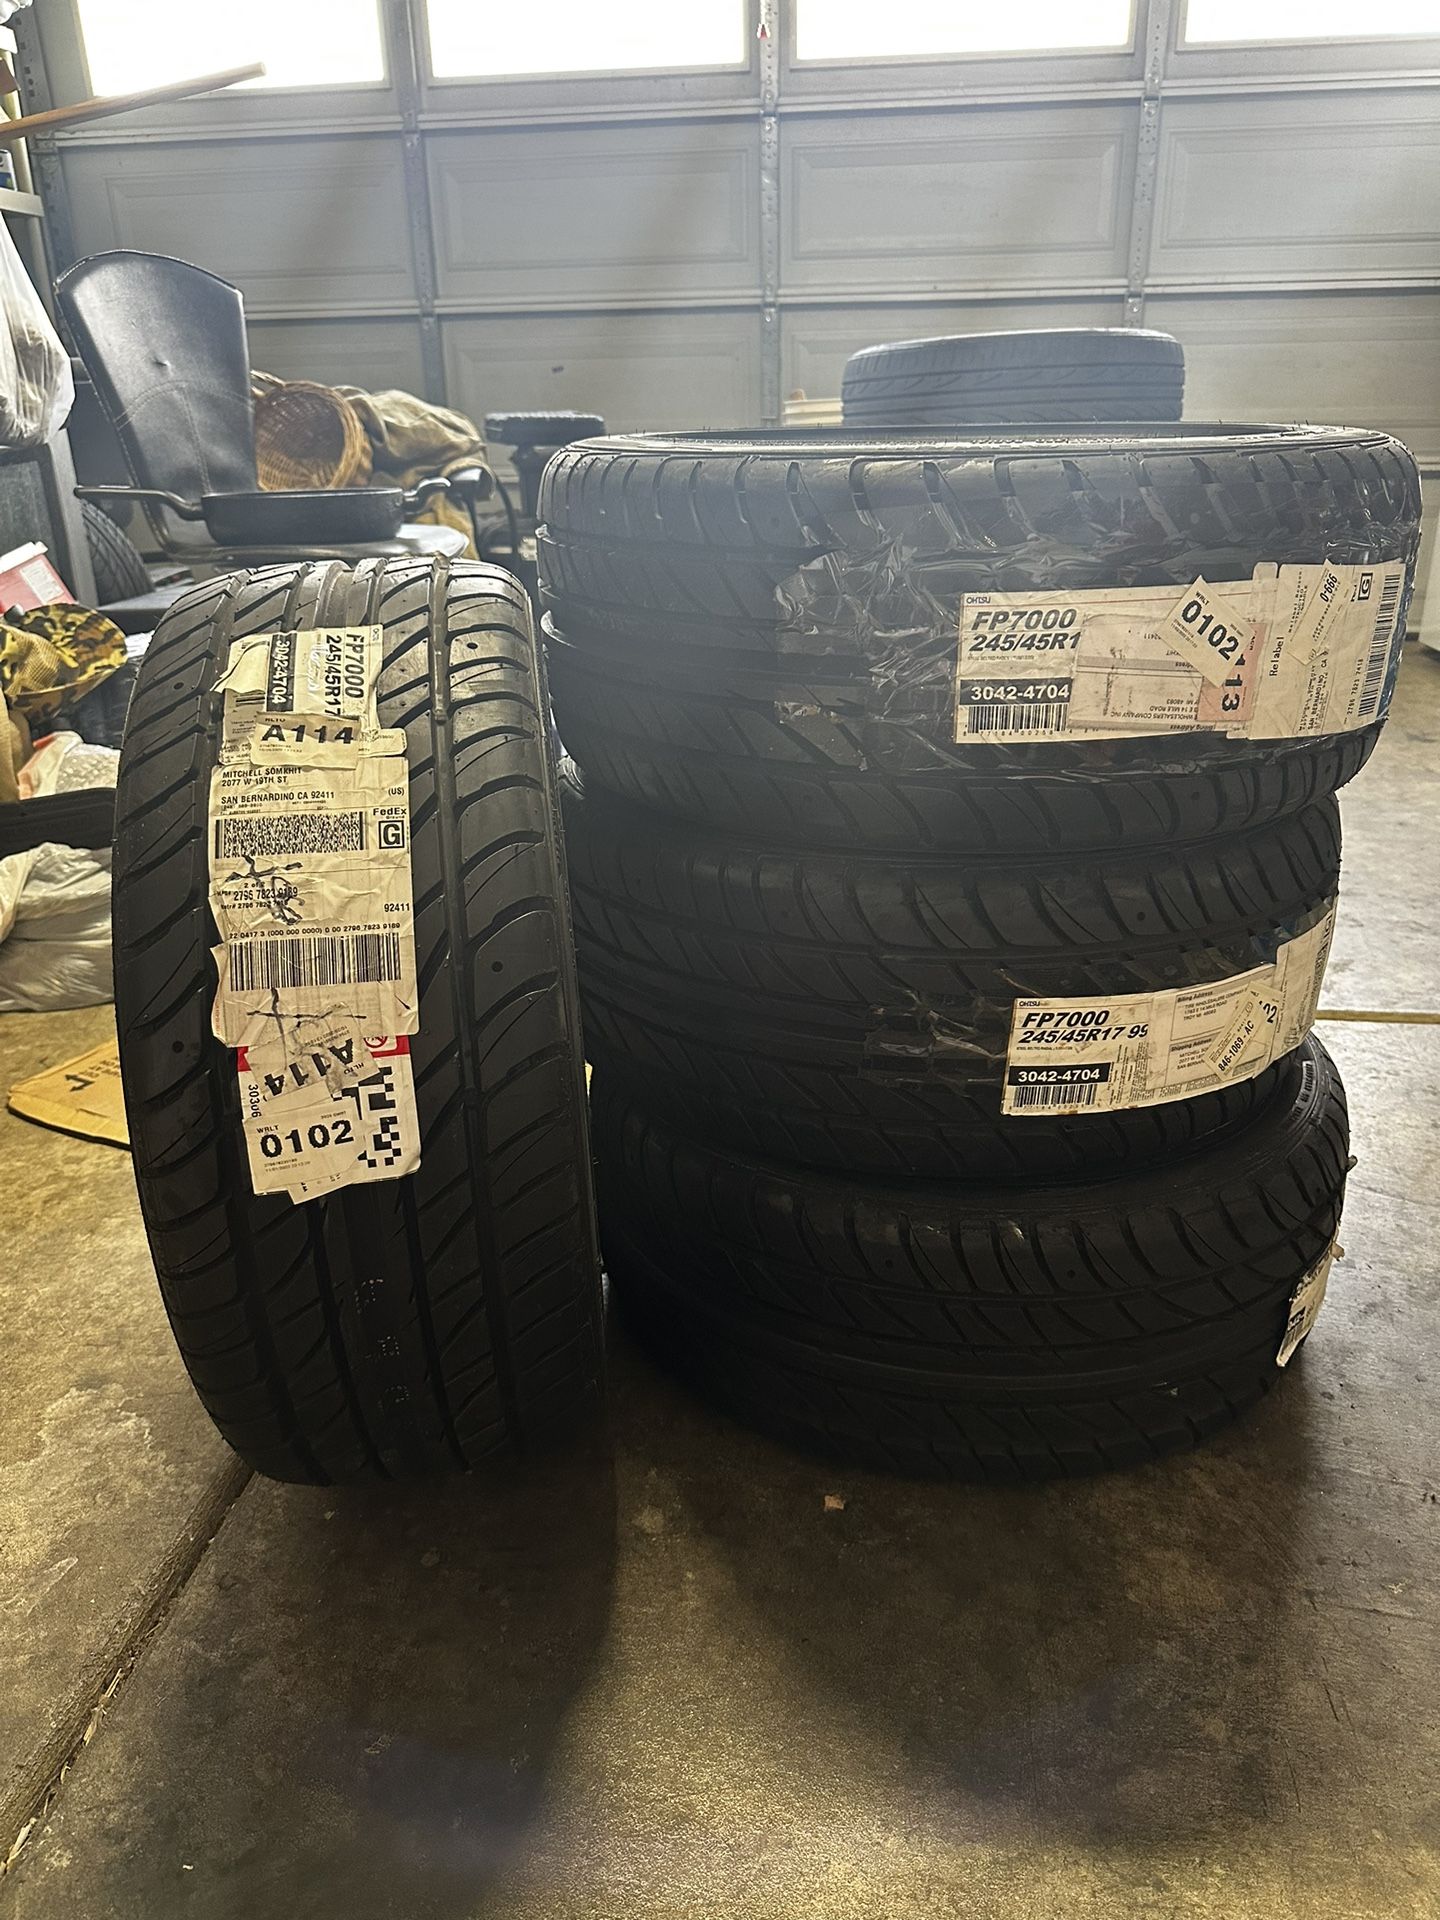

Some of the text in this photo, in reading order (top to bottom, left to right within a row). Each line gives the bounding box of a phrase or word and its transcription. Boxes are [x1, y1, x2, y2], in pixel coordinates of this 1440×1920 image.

[966, 596, 991, 604] OHTSU
[1195, 591, 1210, 606] WRLT
[971, 608, 1077, 631] FP7000
[1181, 599, 1239, 661] 0102
[1269, 636, 1285, 677] Relabel
[272, 639, 291, 704] 3042-4704
[344, 633, 365, 699] FP7000
[324, 634, 342, 717] 245/45R17
[970, 684, 1070, 700] 3042-4704
[1152, 711, 1194, 720] WHOLESALERS
[261, 724, 354, 745] A114
[222, 767, 302, 779] MITCHELL SOMKHIT
[222, 779, 242, 787] 2077
[255, 777, 275, 785] 19TH
[277, 776, 288, 784] ST
[221, 791, 335, 805] SAN BERNARDINO CA 92411
[388, 787, 405, 797] (US)
[373, 807, 407, 816] FedEx
[382, 823, 400, 846] G
[384, 903, 410, 912] 92411
[268, 929, 284, 937] (000
[1021, 1010, 1110, 1028] FP7000
[1018, 1026, 1126, 1043] 245/45R17
[1171, 1043, 1192, 1052] Shipping
[1217, 1036, 1245, 1072] 846-1069
[1244, 1020, 1255, 1036] AC
[264, 1038, 354, 1096] A114
[1018, 1068, 1100, 1082] 3042-4704
[256, 1124, 280, 1134] WRLT
[260, 1119, 354, 1158] 0102
